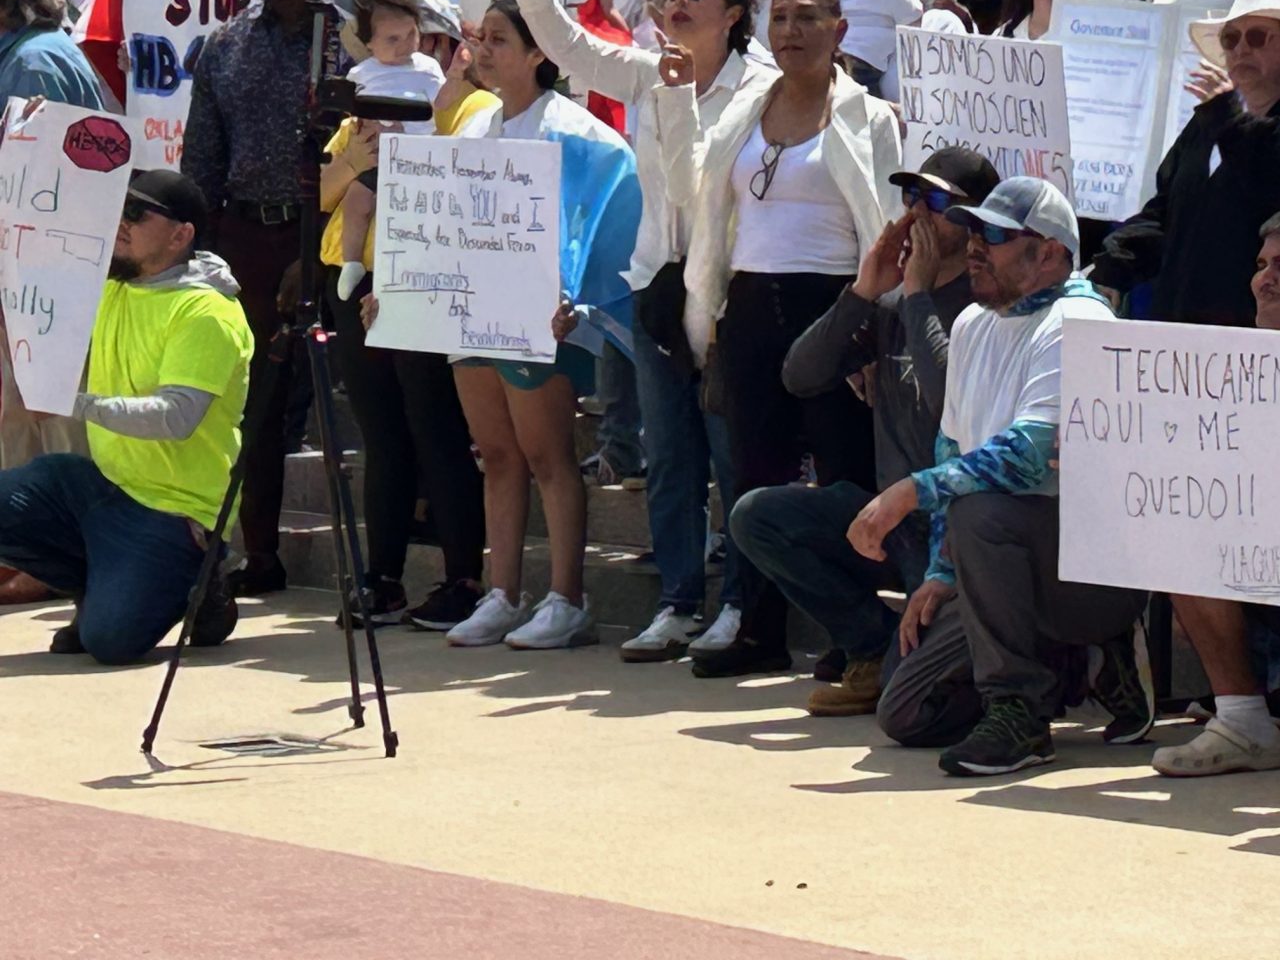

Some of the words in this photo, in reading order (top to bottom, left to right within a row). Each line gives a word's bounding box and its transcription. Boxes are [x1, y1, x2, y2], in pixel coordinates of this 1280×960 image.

[926, 35, 996, 86] SOMOS
[1002, 44, 1046, 88] UNO
[929, 87, 1002, 135] SOMOS
[1003, 93, 1048, 139] CIEN
[1064, 396, 1144, 444] AQUI
[1198, 411, 1241, 452] ME
